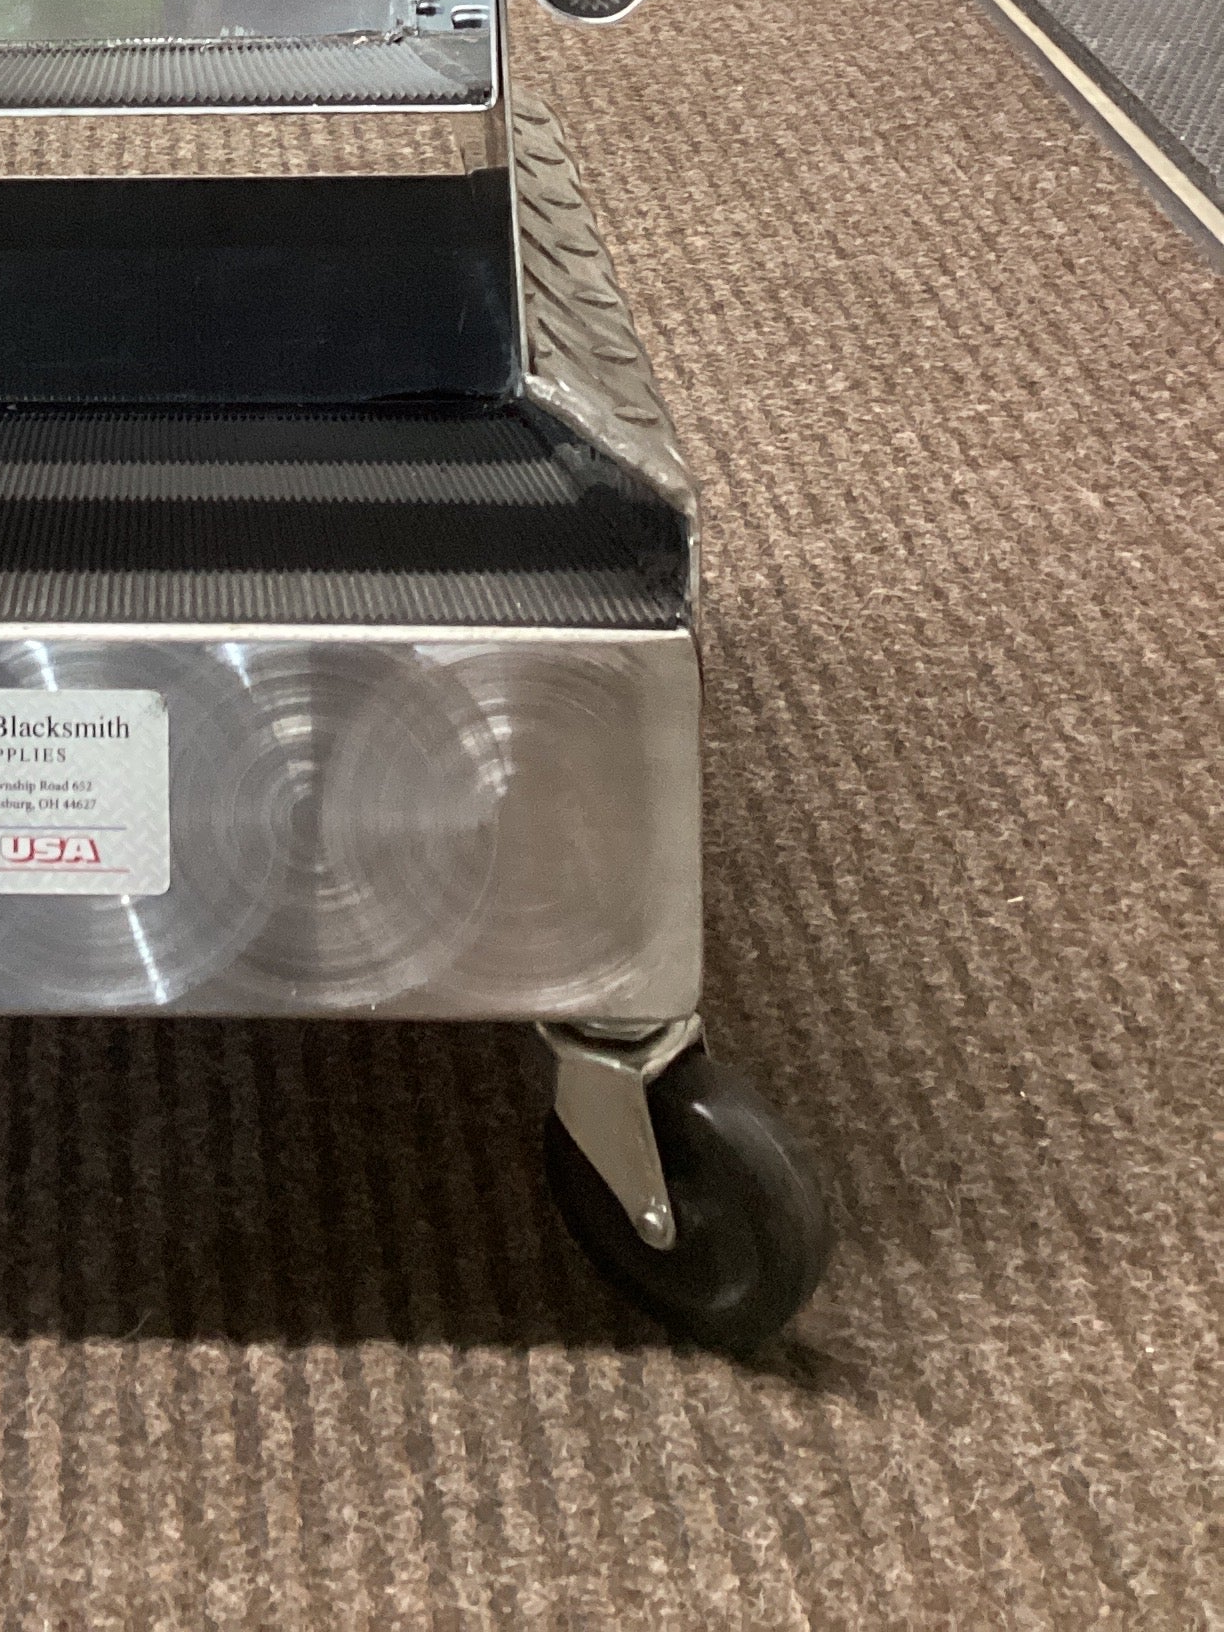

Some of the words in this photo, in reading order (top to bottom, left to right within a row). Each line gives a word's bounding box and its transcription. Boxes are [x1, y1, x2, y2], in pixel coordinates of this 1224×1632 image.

[40, 779, 69, 792] Road
[38, 798, 59, 810] OH
[63, 798, 97, 810] 44627
[0, 835, 101, 864] USA
